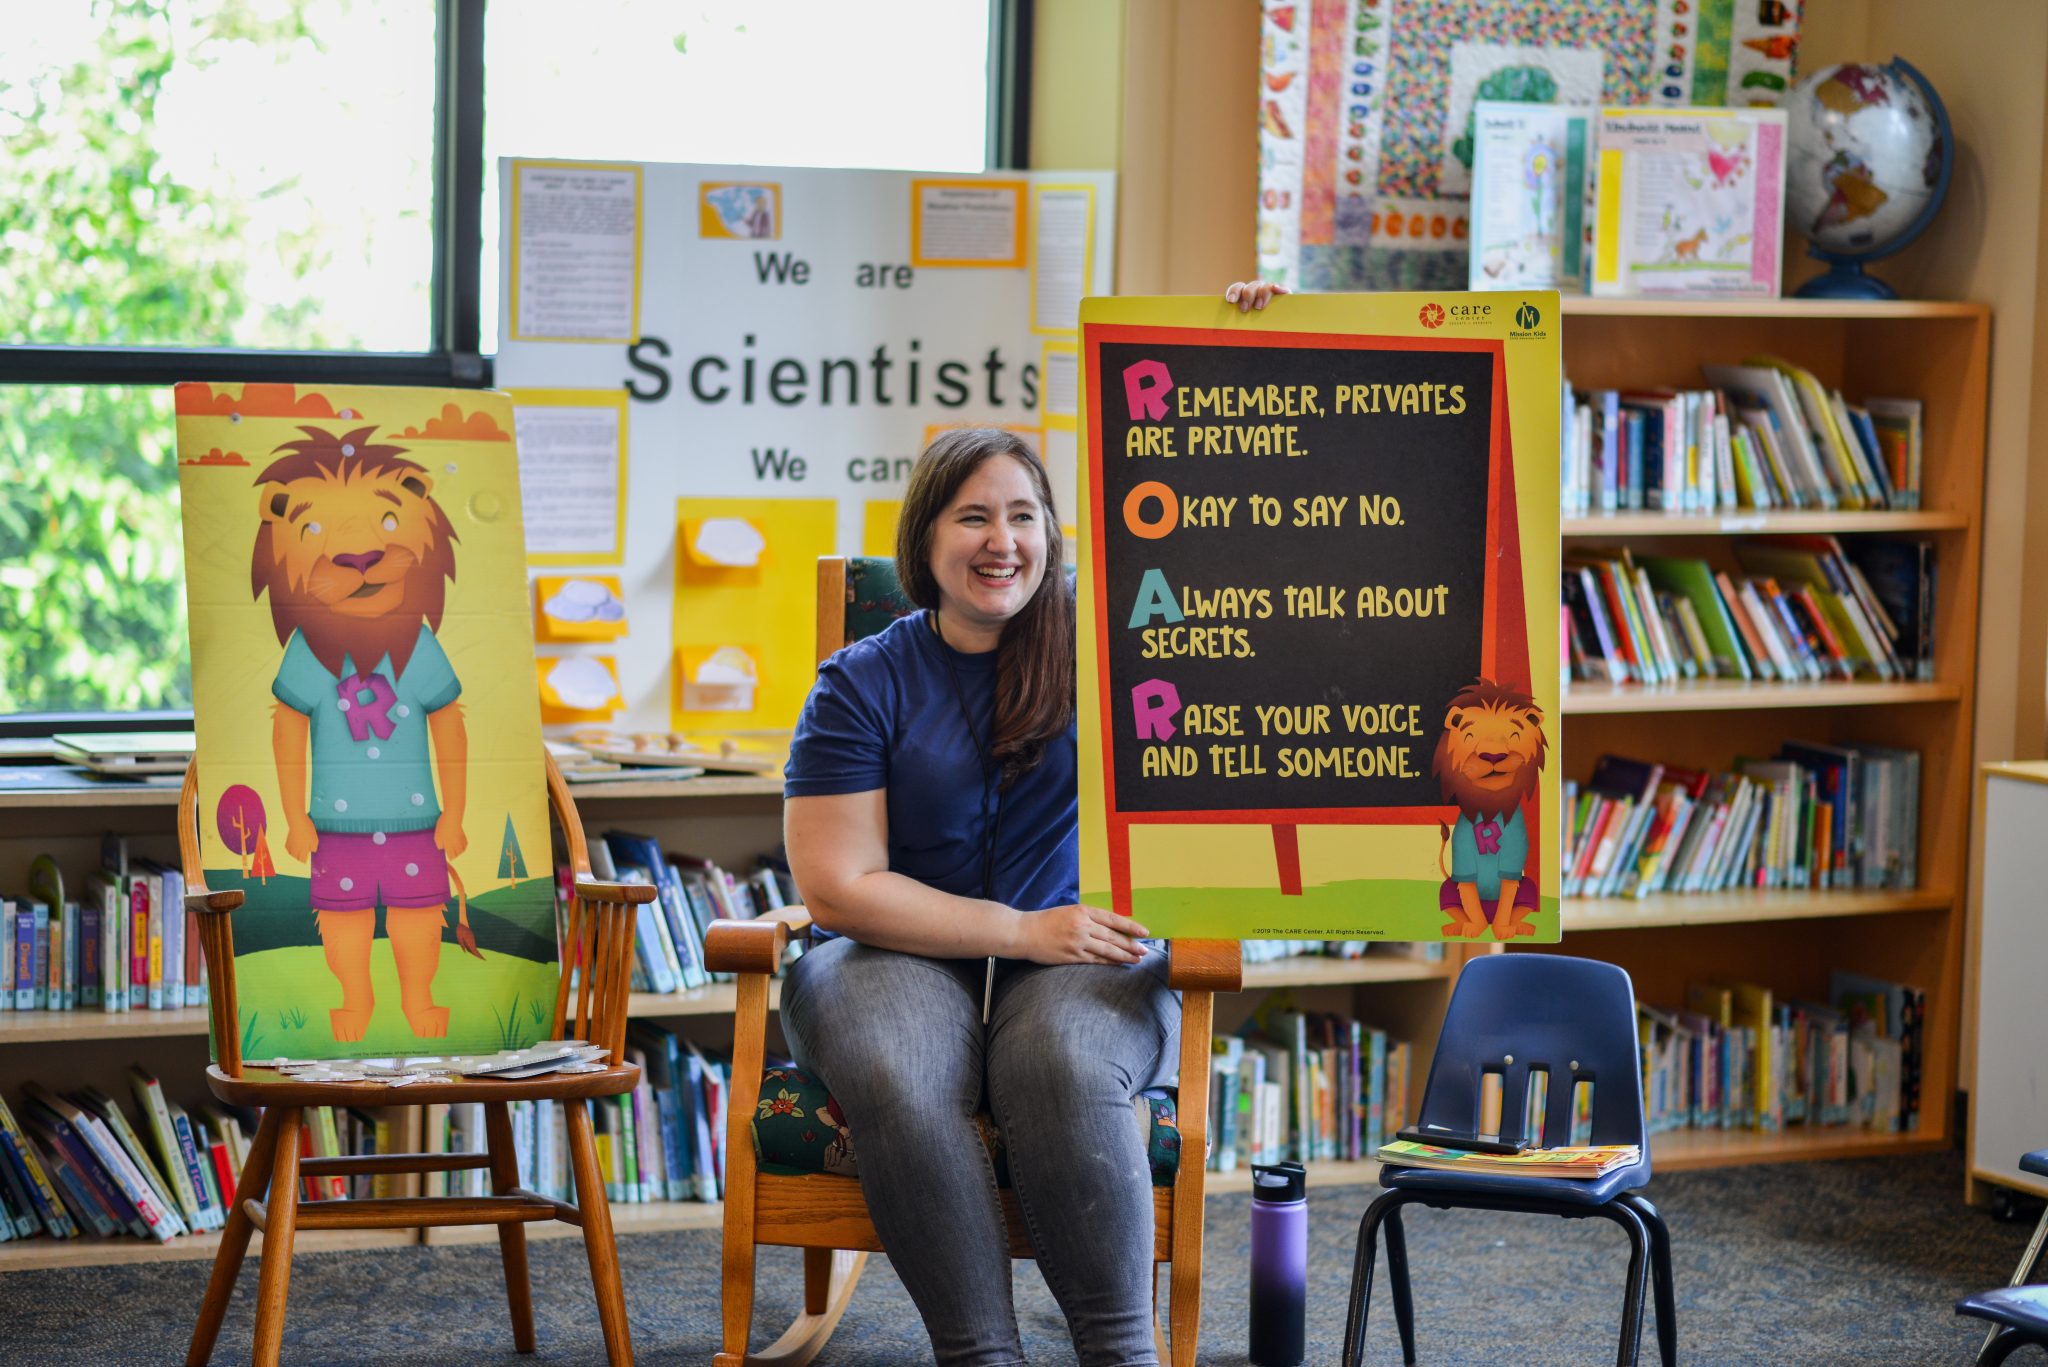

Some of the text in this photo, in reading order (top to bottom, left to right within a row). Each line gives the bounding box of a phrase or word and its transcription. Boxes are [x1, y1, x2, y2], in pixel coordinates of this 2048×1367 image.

[754, 251, 914, 288] We are
[1450, 304, 1491, 315] care
[623, 334, 1040, 410] Scientists
[1122, 359, 1467, 422] REMEMBER, PRIVATES
[1126, 423, 1308, 458] ARE PRIVATE.
[751, 448, 913, 482] We can
[1122, 481, 1406, 539] OKAY TO SAY NO.
[1127, 568, 1448, 629] ALWAYS TALK ABOUT
[1141, 625, 1256, 659] SECRETS.
[336, 672, 398, 742] R
[1131, 678, 1424, 742] RAISE YOUR VOICE
[1142, 744, 1421, 778] AND TELL SOMEONE.
[1473, 820, 1503, 856] R
